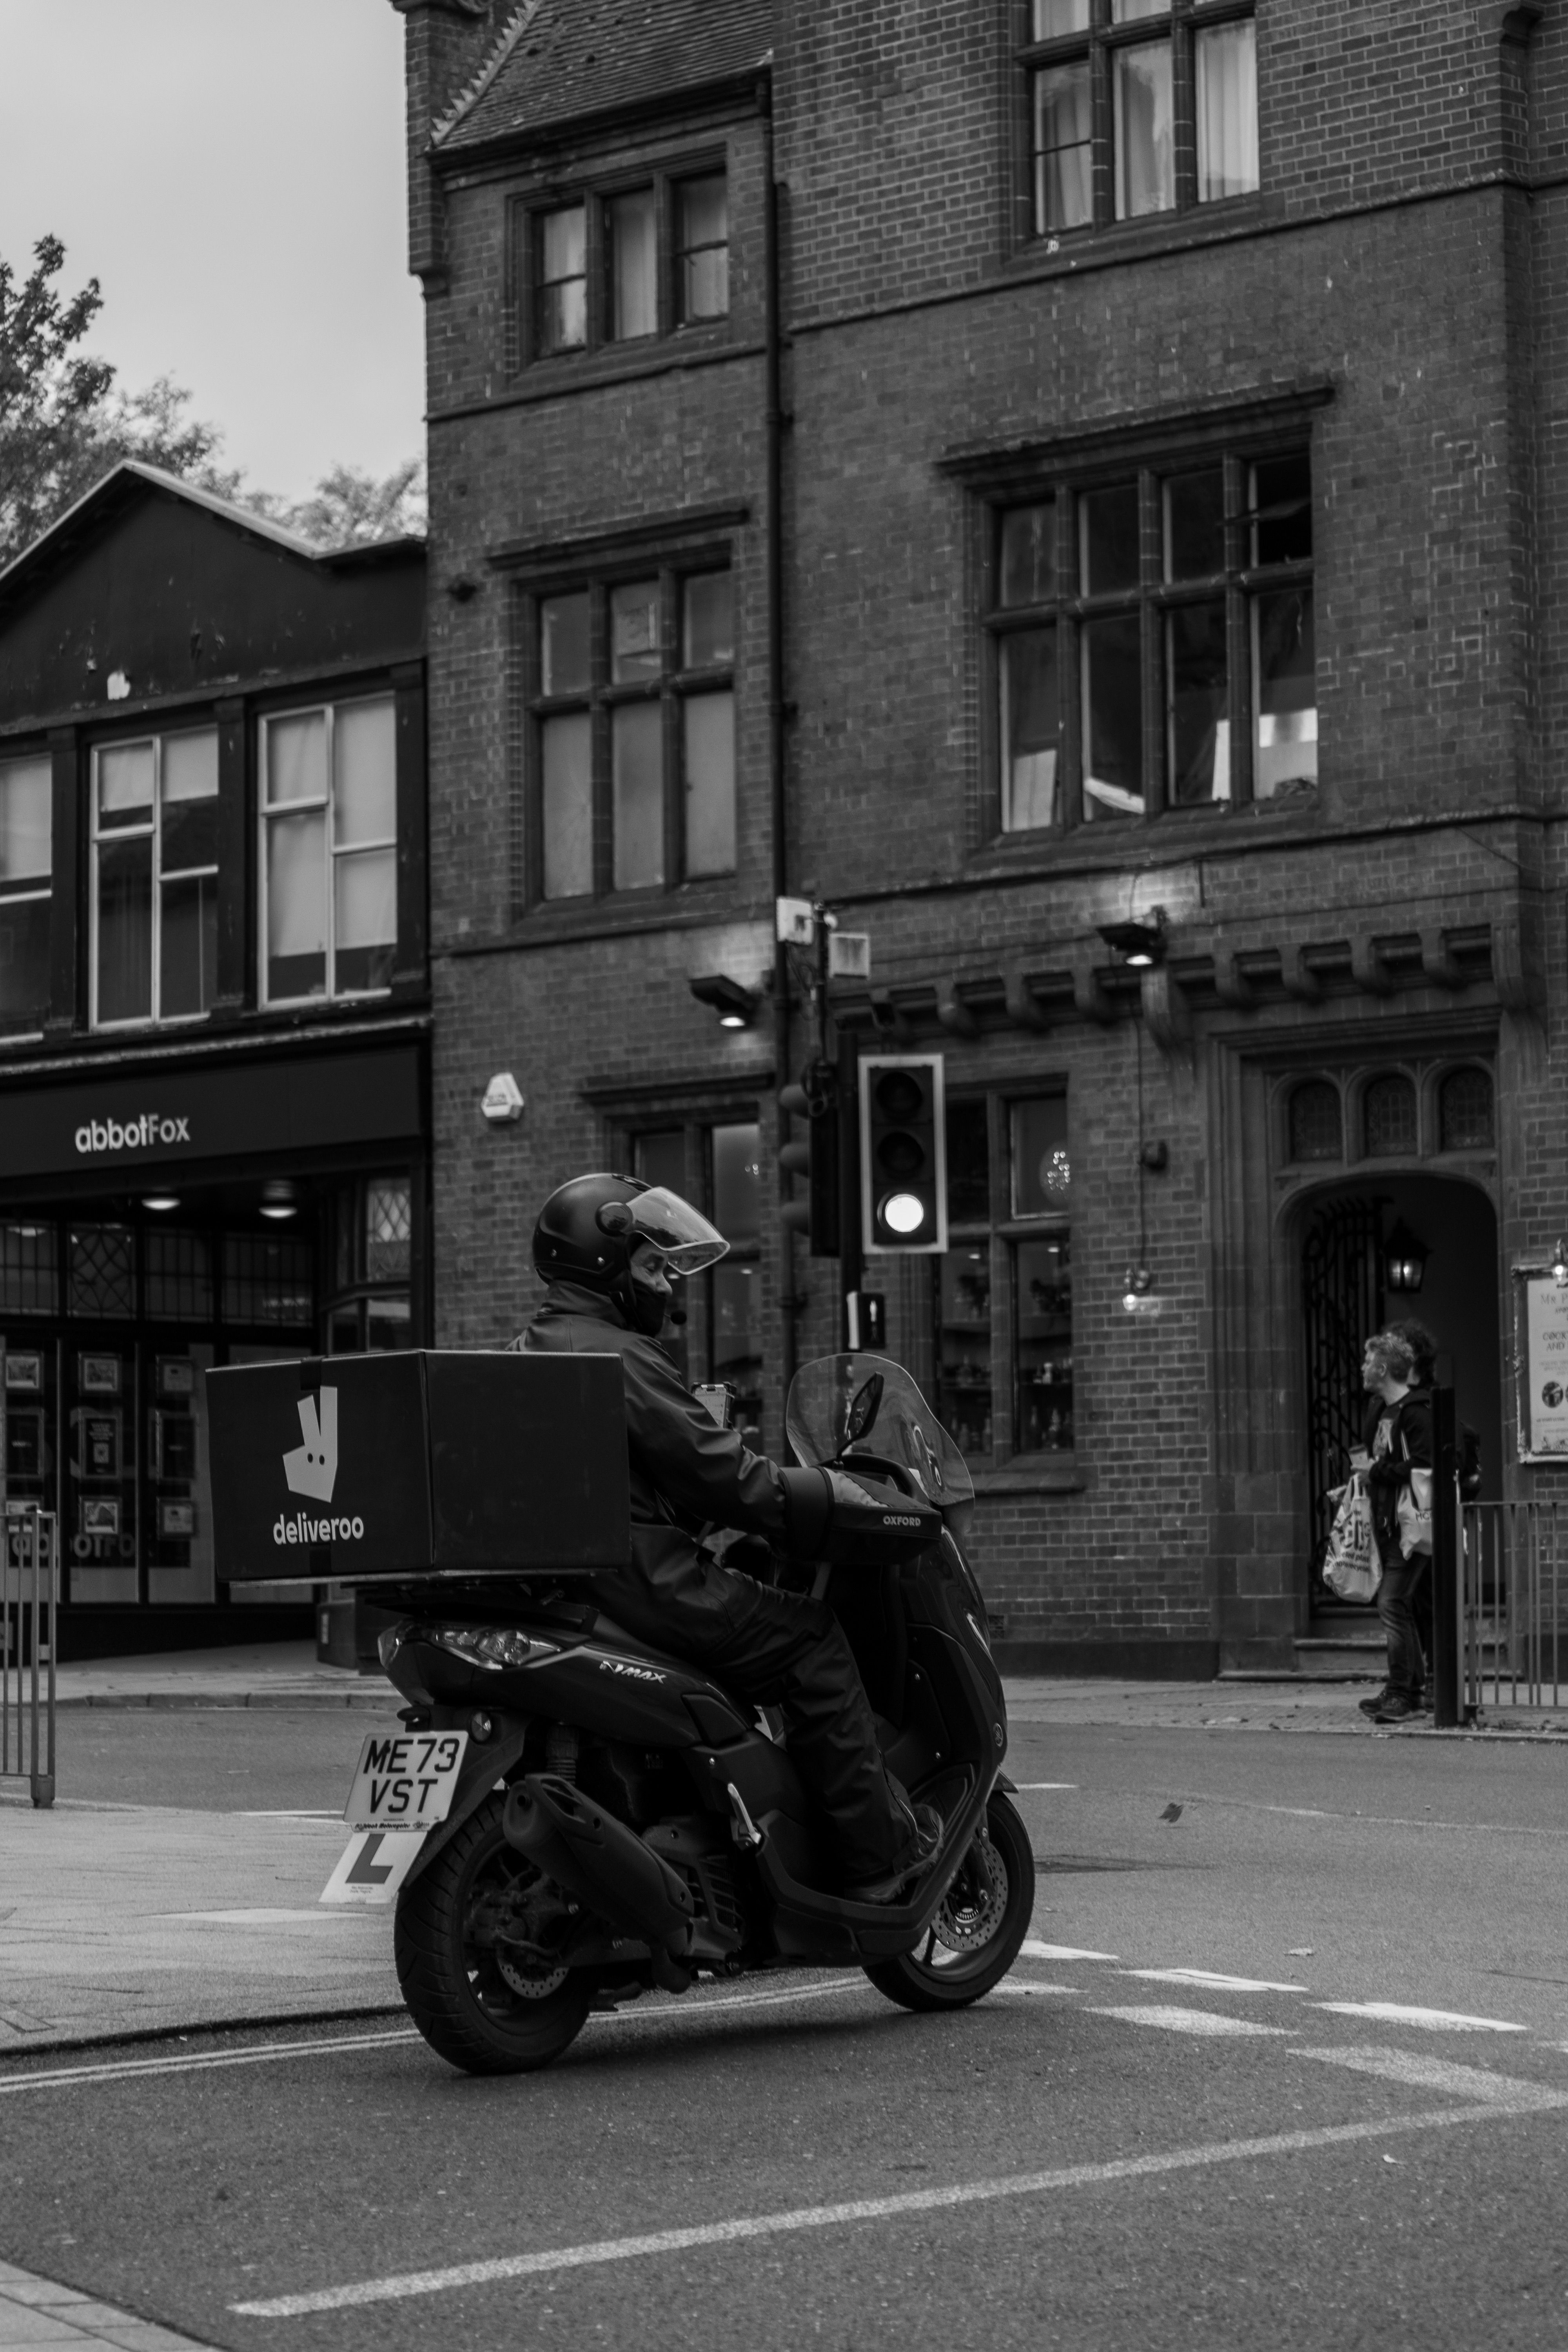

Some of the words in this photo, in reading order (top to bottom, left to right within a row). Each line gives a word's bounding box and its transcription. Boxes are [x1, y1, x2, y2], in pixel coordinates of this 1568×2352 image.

[75, 1113, 191, 1153] abbotFox
[273, 1512, 364, 1545] deliveroo
[883, 1515, 921, 1527] OXFORD
[599, 1660, 667, 1684] NMAX
[363, 1738, 460, 1774] ME73
[370, 1779, 439, 1814] VST
[345, 1833, 393, 1884] L
